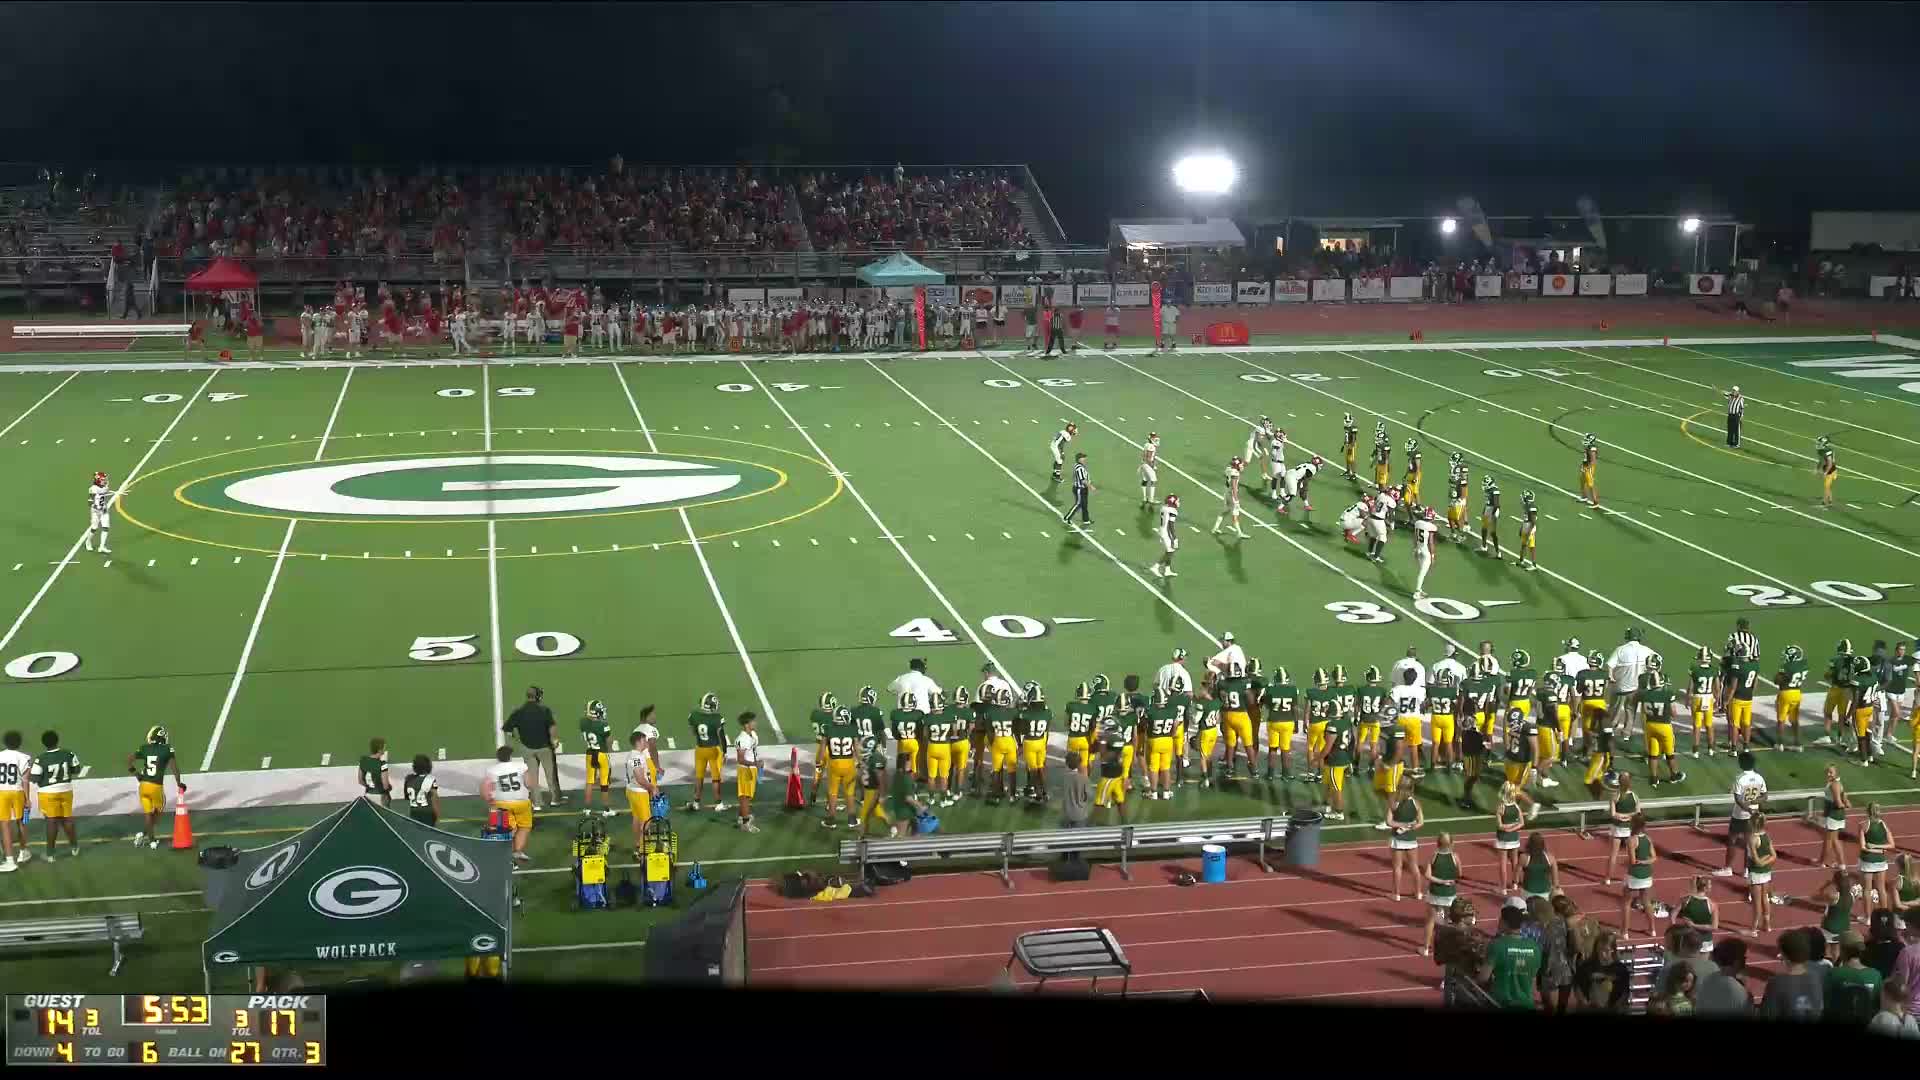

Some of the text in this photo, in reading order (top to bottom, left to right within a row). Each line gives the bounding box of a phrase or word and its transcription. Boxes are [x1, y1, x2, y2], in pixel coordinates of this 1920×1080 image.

[224, 456, 741, 516] G
[1585, 680, 1604, 696] 35
[1271, 698, 1292, 712] 75
[1030, 720, 1047, 737] 19
[1071, 713, 1092, 732] 85
[930, 724, 951, 741] 27
[829, 737, 852, 756] 62
[48, 761, 71, 784] 71
[147, 756, 157, 777] 5
[498, 777, 521, 797] 55
[315, 870, 402, 916] G
[316, 943, 397, 959] WOLFPACK
